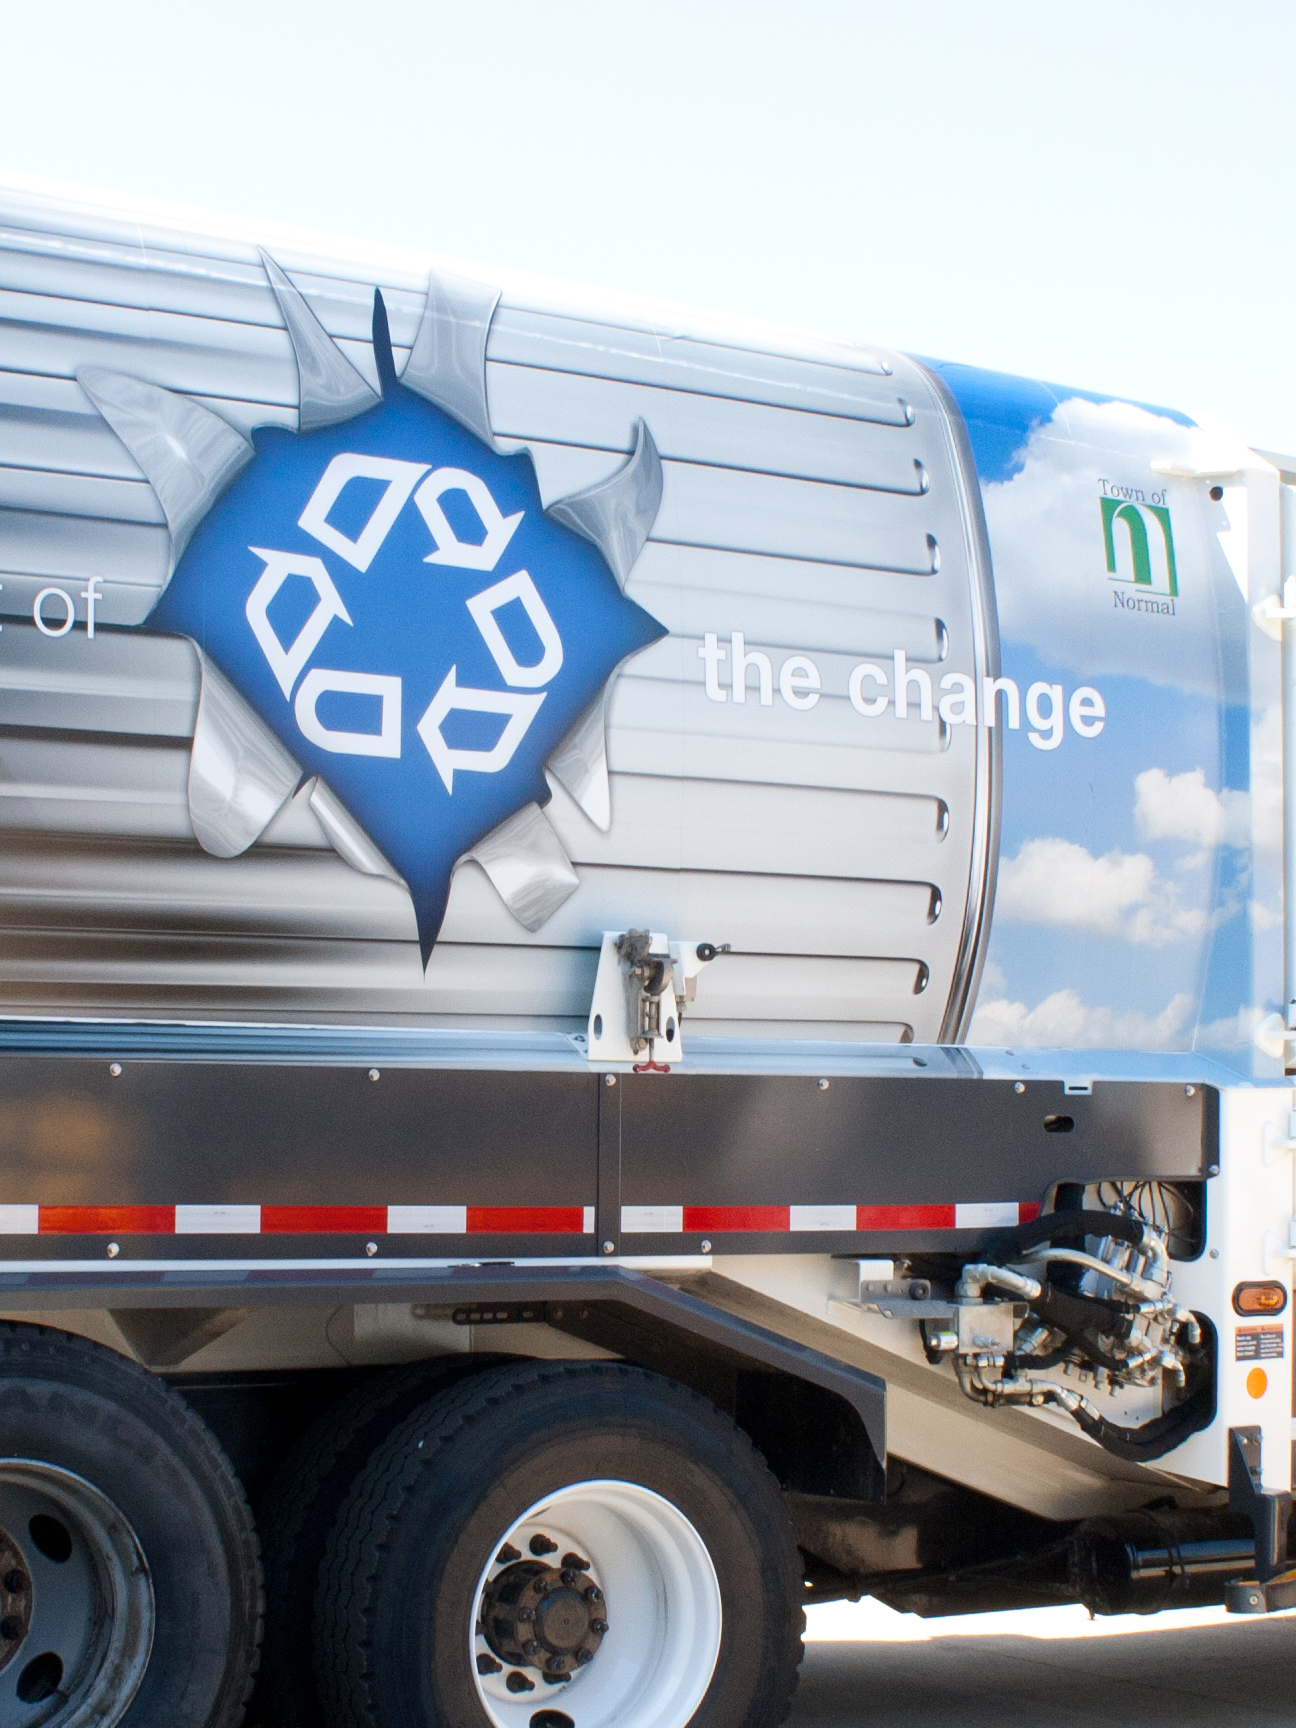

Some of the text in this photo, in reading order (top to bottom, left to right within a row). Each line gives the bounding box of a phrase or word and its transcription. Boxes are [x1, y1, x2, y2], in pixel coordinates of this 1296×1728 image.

[1098, 478, 1167, 506] Town of
[33, 576, 104, 639] of
[1113, 590, 1176, 616] Normal
[697, 631, 1106, 751] the change
